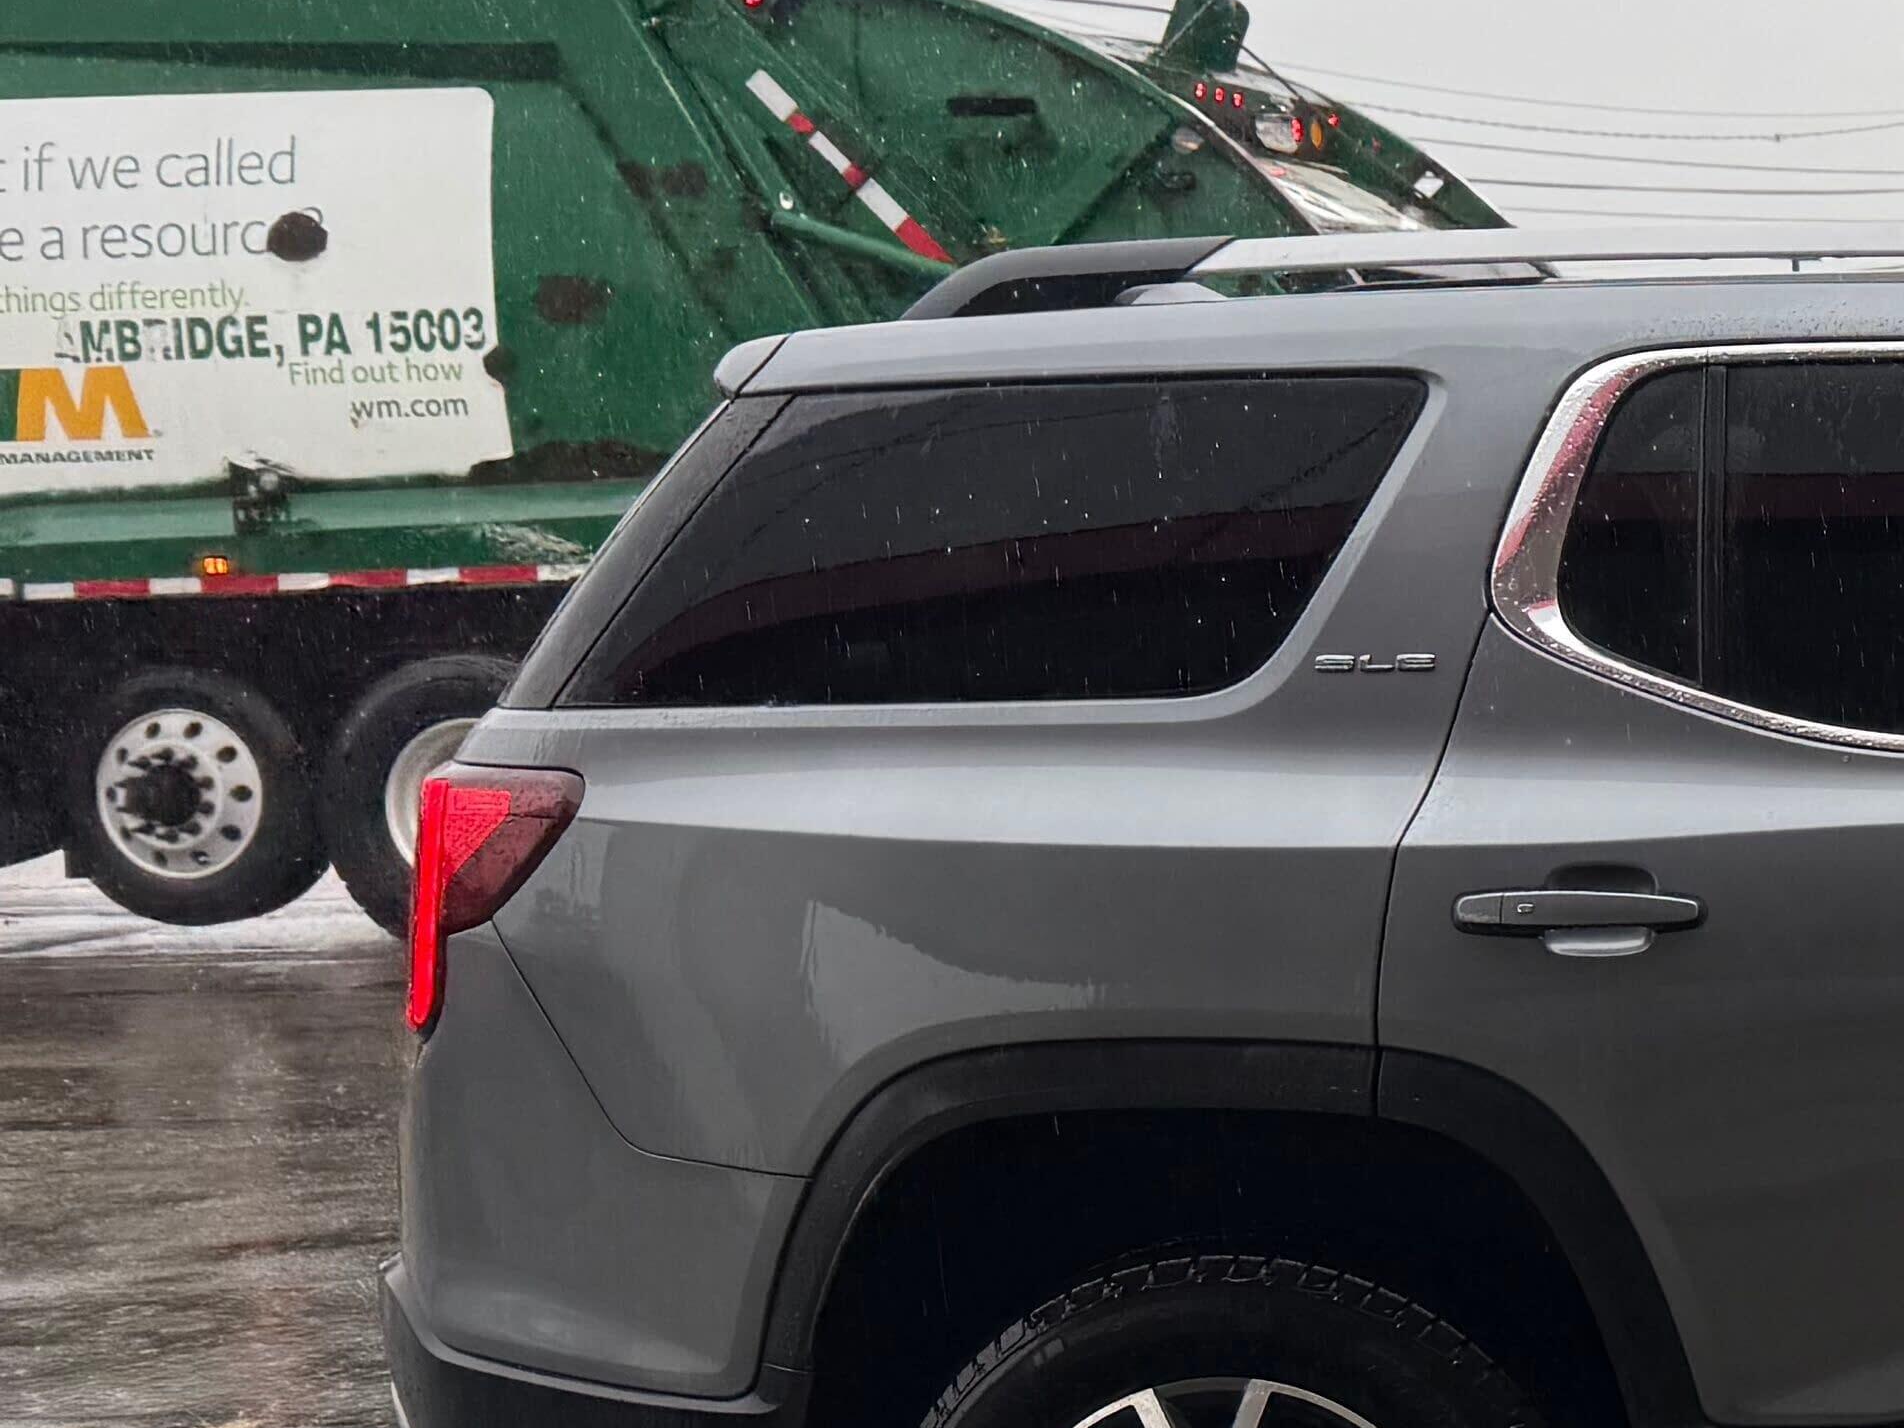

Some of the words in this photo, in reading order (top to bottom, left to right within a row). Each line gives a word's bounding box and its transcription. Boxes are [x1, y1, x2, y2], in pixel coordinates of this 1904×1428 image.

[23, 142, 55, 191] if
[68, 154, 141, 190] we
[156, 134, 296, 187] called
[40, 225, 65, 260] a
[82, 206, 324, 260] resourc
[89, 277, 249, 315] differently.
[55, 314, 284, 368] MBIDGE,
[297, 312, 352, 356] PA
[366, 307, 486, 354] 15003
[288, 359, 345, 385] Find
[351, 361, 399, 384] out
[405, 357, 463, 382] how
[0, 366, 151, 442] M
[352, 397, 469, 419] wm.com
[0, 448, 155, 465] MANAGEMENT
[1314, 653, 1436, 672] SLE
